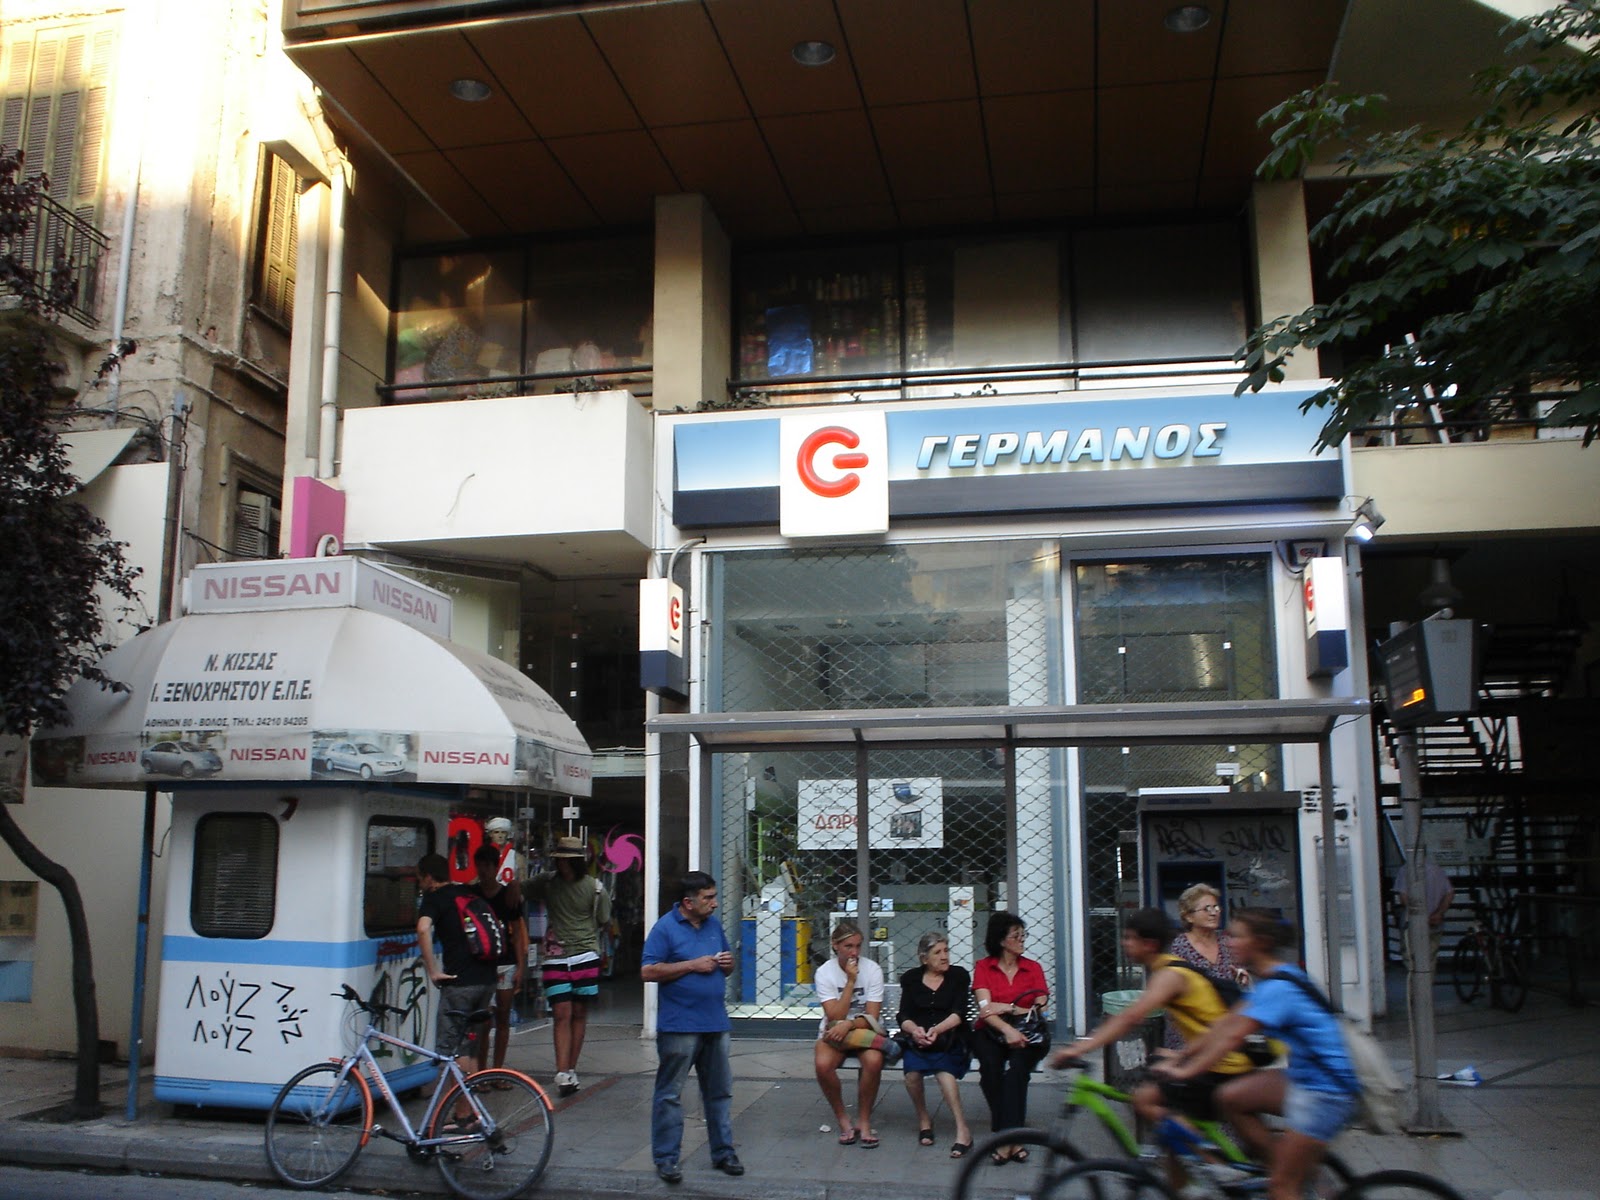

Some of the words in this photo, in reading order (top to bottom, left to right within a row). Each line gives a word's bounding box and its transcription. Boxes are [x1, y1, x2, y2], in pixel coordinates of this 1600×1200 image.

[916, 422, 1229, 470] ΓΕΡΜΑΝΟΣ
[204, 572, 340, 599] NISSAN
[372, 579, 438, 624] NISSAN
[223, 652, 278, 671] ΚΙΣΣΑΣ
[163, 680, 271, 702] ΞΕΝΟΧΡΗΣΤΟΥ
[86, 751, 137, 766] NISSAN
[230, 748, 306, 761] NISSAN
[423, 750, 510, 766] NISSAN
[563, 764, 591, 780] NISSAN
